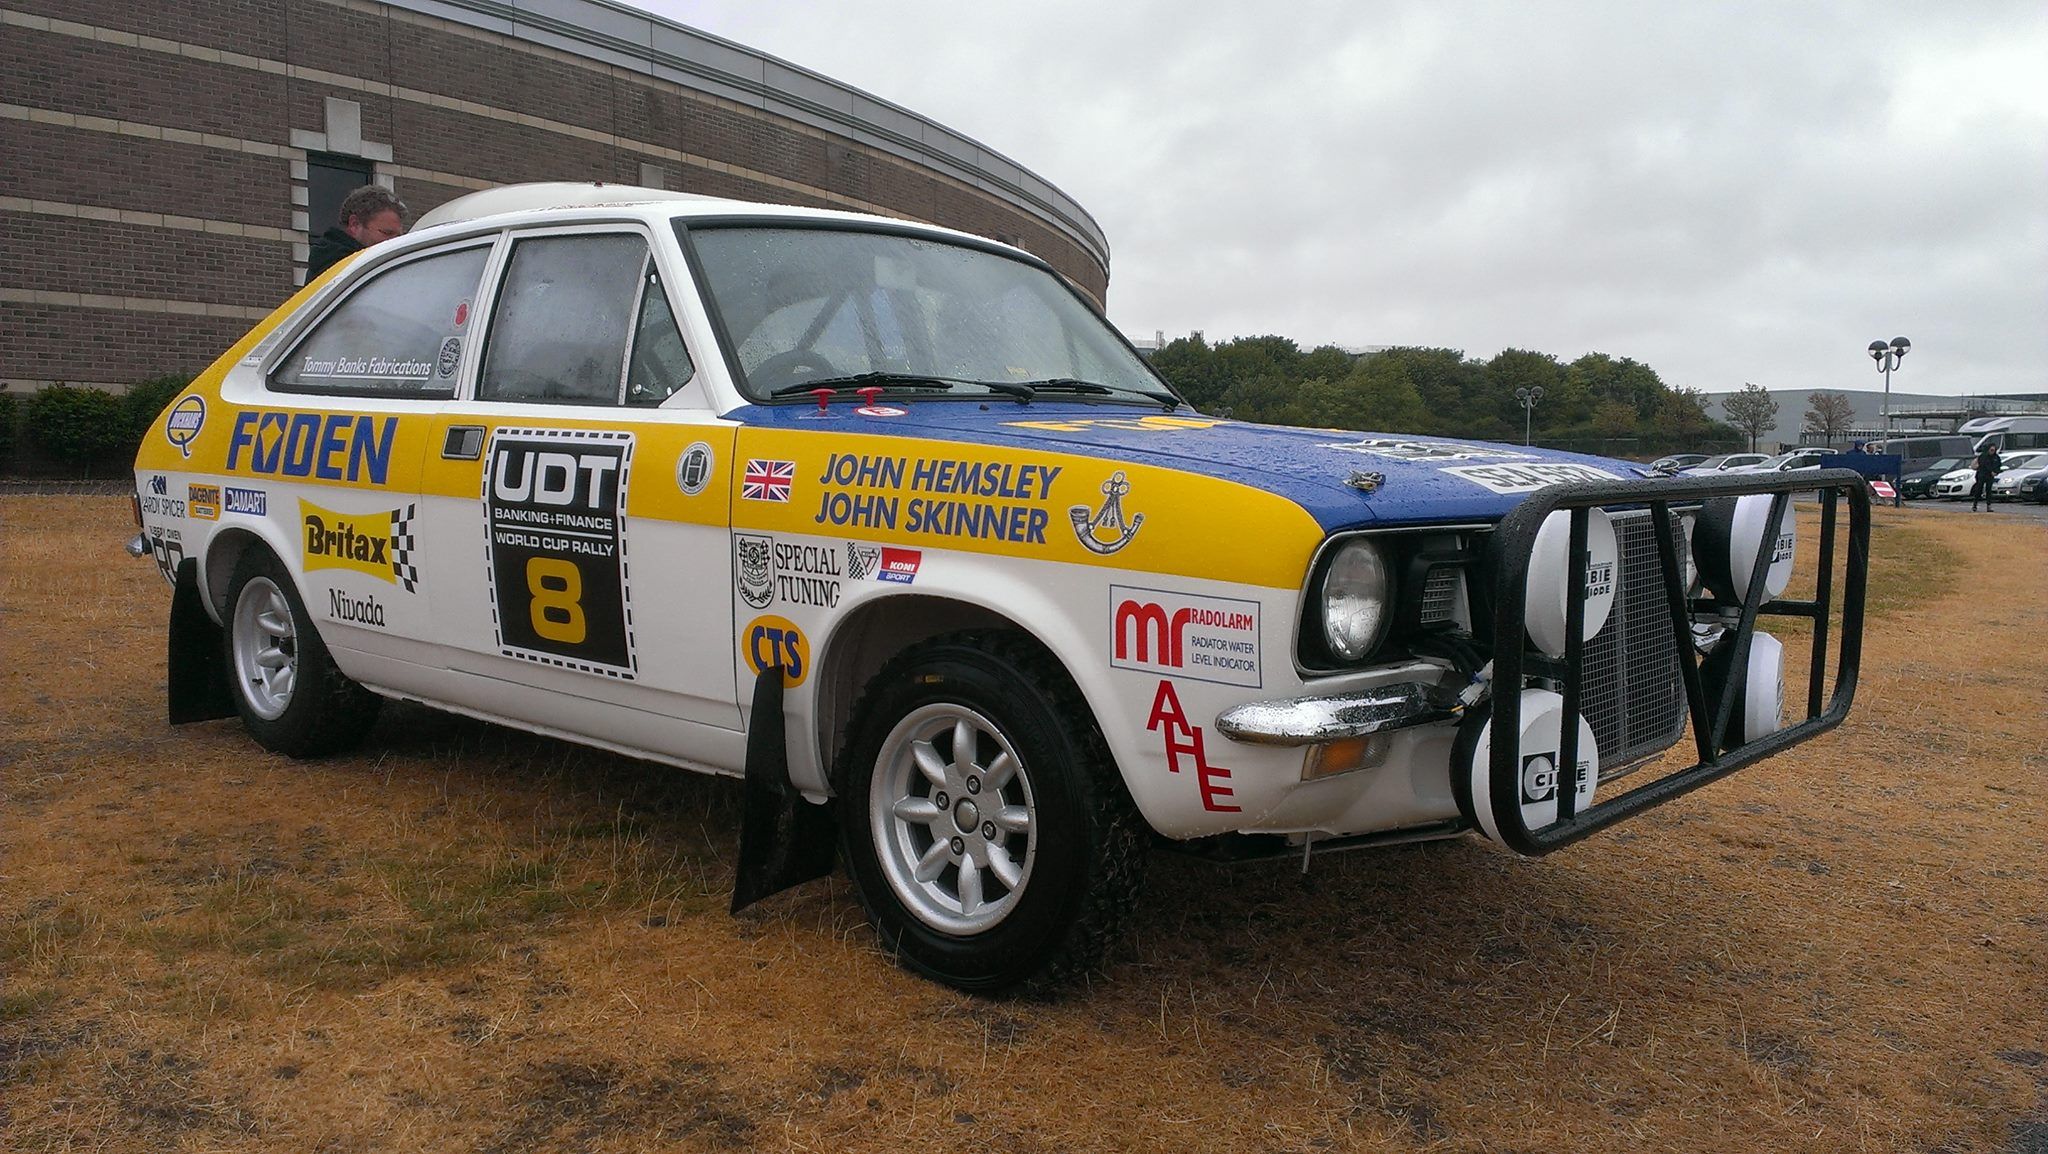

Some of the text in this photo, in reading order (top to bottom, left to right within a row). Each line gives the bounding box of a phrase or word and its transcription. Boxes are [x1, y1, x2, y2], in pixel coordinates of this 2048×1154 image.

[302, 357, 336, 376] Tommy
[337, 357, 367, 374] Banks
[368, 357, 432, 376] Fabrications
[226, 411, 399, 484] FODEN
[494, 450, 618, 508] UDT
[819, 453, 1062, 501] JOHN HEMSLEY
[161, 498, 185, 518] SPICER
[227, 490, 265, 514] DAMART
[815, 492, 1048, 545] JOHN SKINNER
[305, 515, 387, 565] Britax
[495, 532, 613, 557] WORLD CUP RALLY
[775, 542, 842, 576] SPECIAL
[889, 561, 915, 571] KONI
[777, 574, 841, 608] TUNING
[885, 572, 911, 582] SPORT
[329, 588, 385, 626] Nivada
[526, 557, 586, 643] 8
[1191, 608, 1253, 631] RADOLARM
[750, 625, 802, 679] CTS
[1191, 636, 1255, 655] RADIATOR WATER
[1191, 653, 1256, 672] LEVEL INDICATOR
